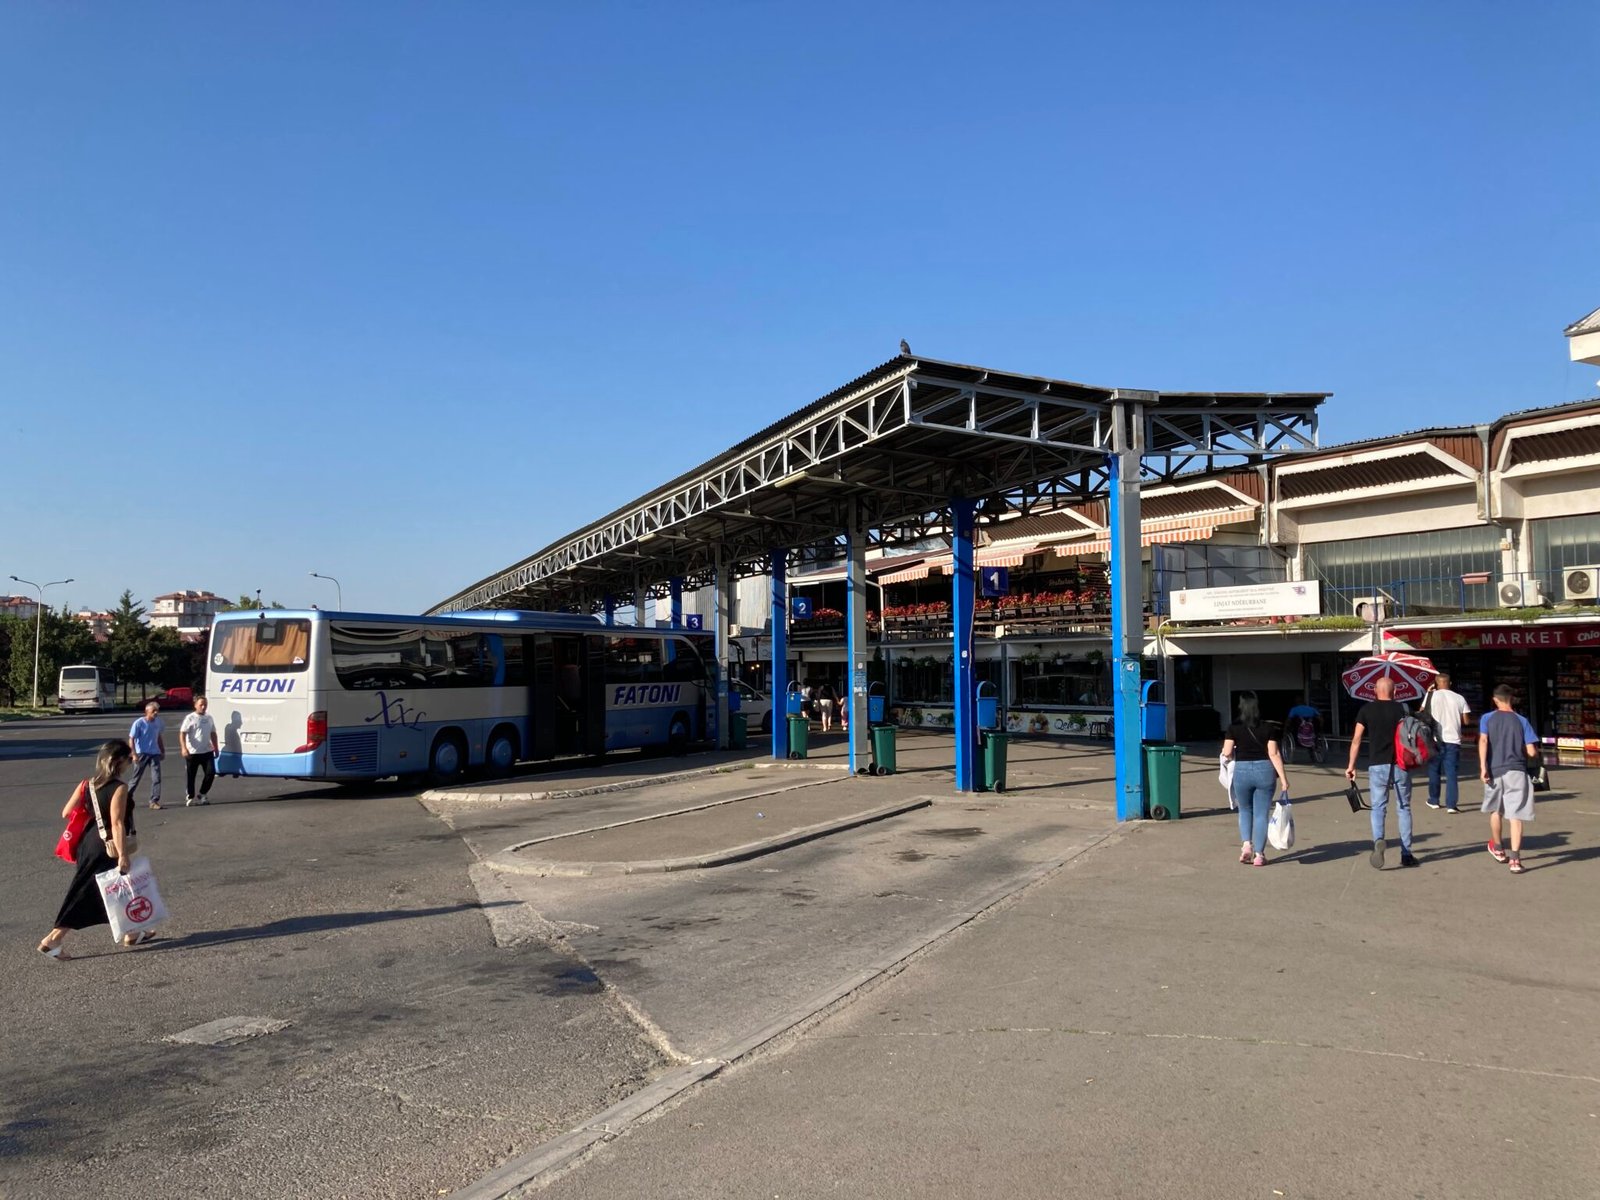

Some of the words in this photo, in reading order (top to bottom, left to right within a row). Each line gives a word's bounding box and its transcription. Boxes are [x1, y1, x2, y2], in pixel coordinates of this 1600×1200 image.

[990, 571, 999, 591] 1
[798, 602, 806, 614] 2
[691, 617, 699, 629] 3
[1481, 631, 1563, 645] MARKET
[220, 679, 295, 693] FATONI
[613, 684, 681, 705] FATONI
